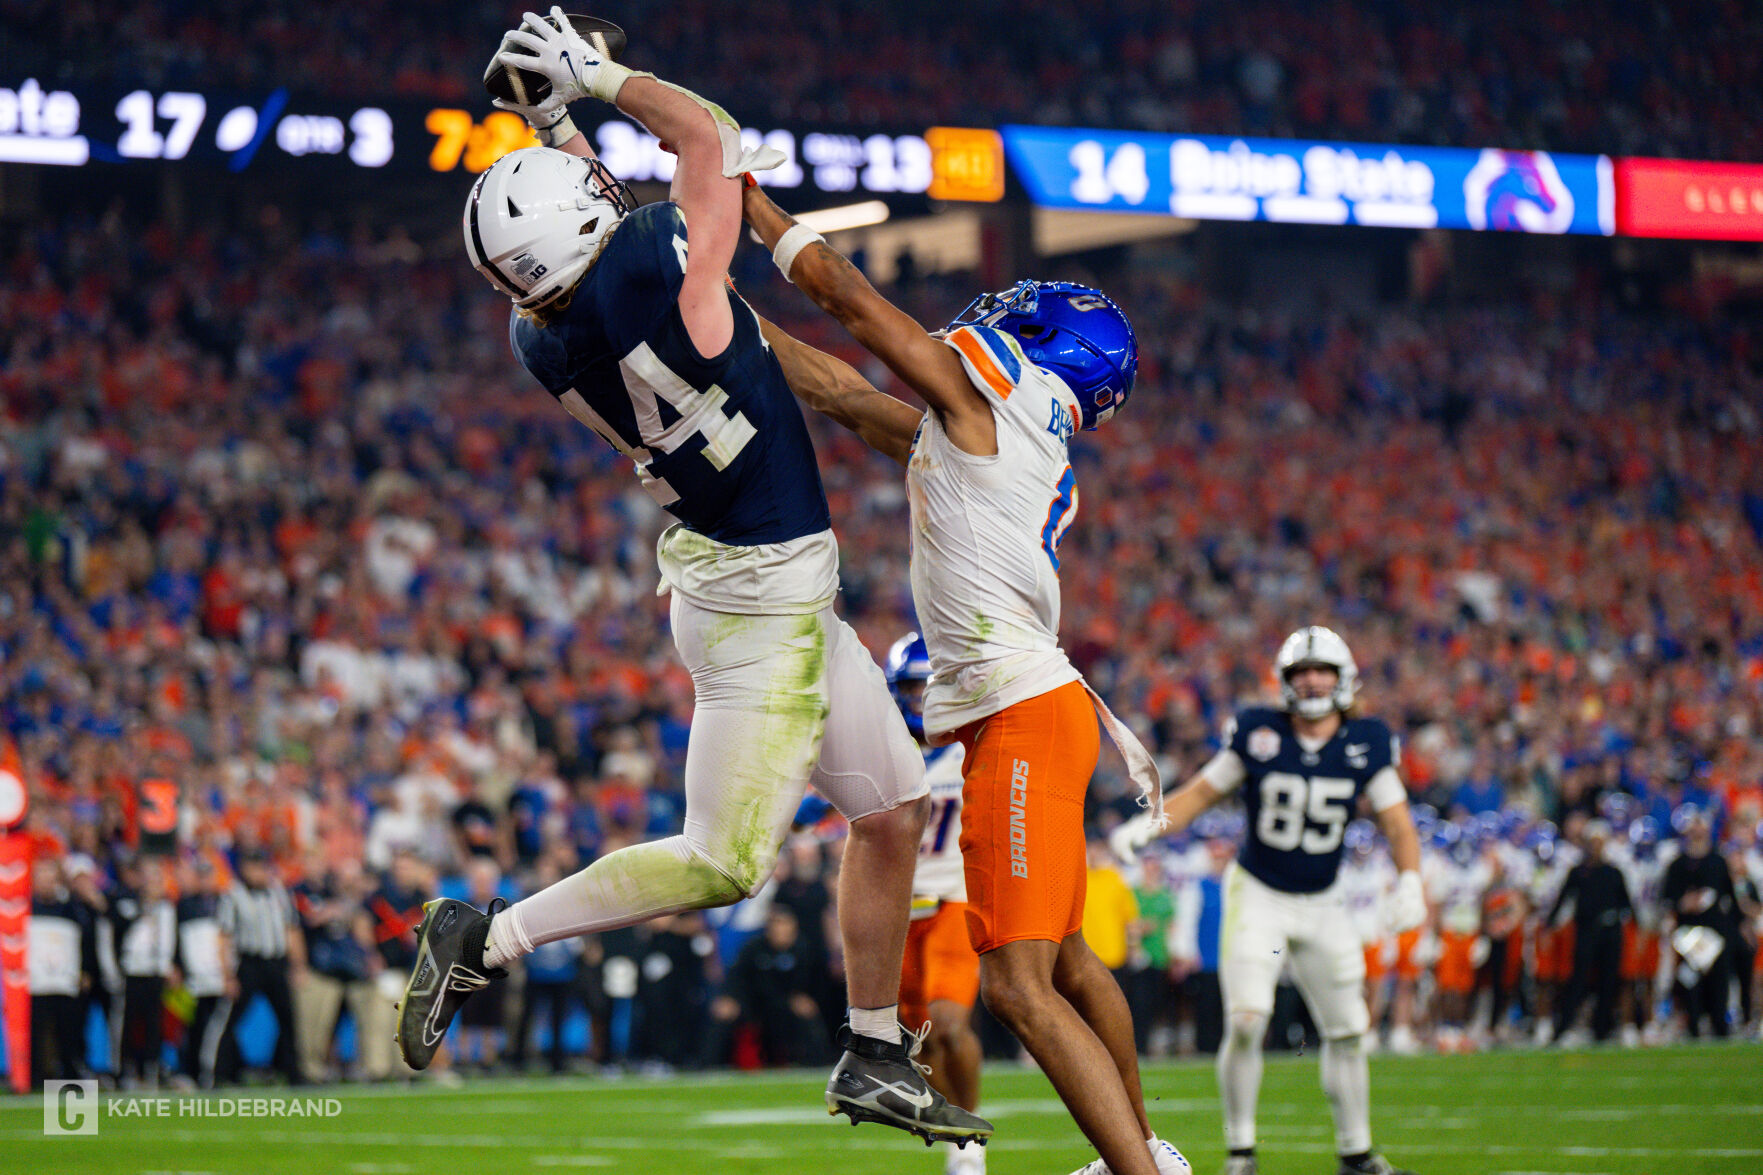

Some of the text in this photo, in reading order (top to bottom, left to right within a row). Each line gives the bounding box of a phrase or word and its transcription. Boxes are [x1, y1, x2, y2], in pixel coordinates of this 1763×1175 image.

[115, 89, 207, 160] 17
[349, 107, 394, 168] 3
[860, 133, 934, 193] 13
[1069, 138, 1435, 205] 14 Boise State
[141, 779, 178, 833] 3
[1009, 758, 1029, 879] BRONCOS
[1256, 771, 1356, 854] 85
